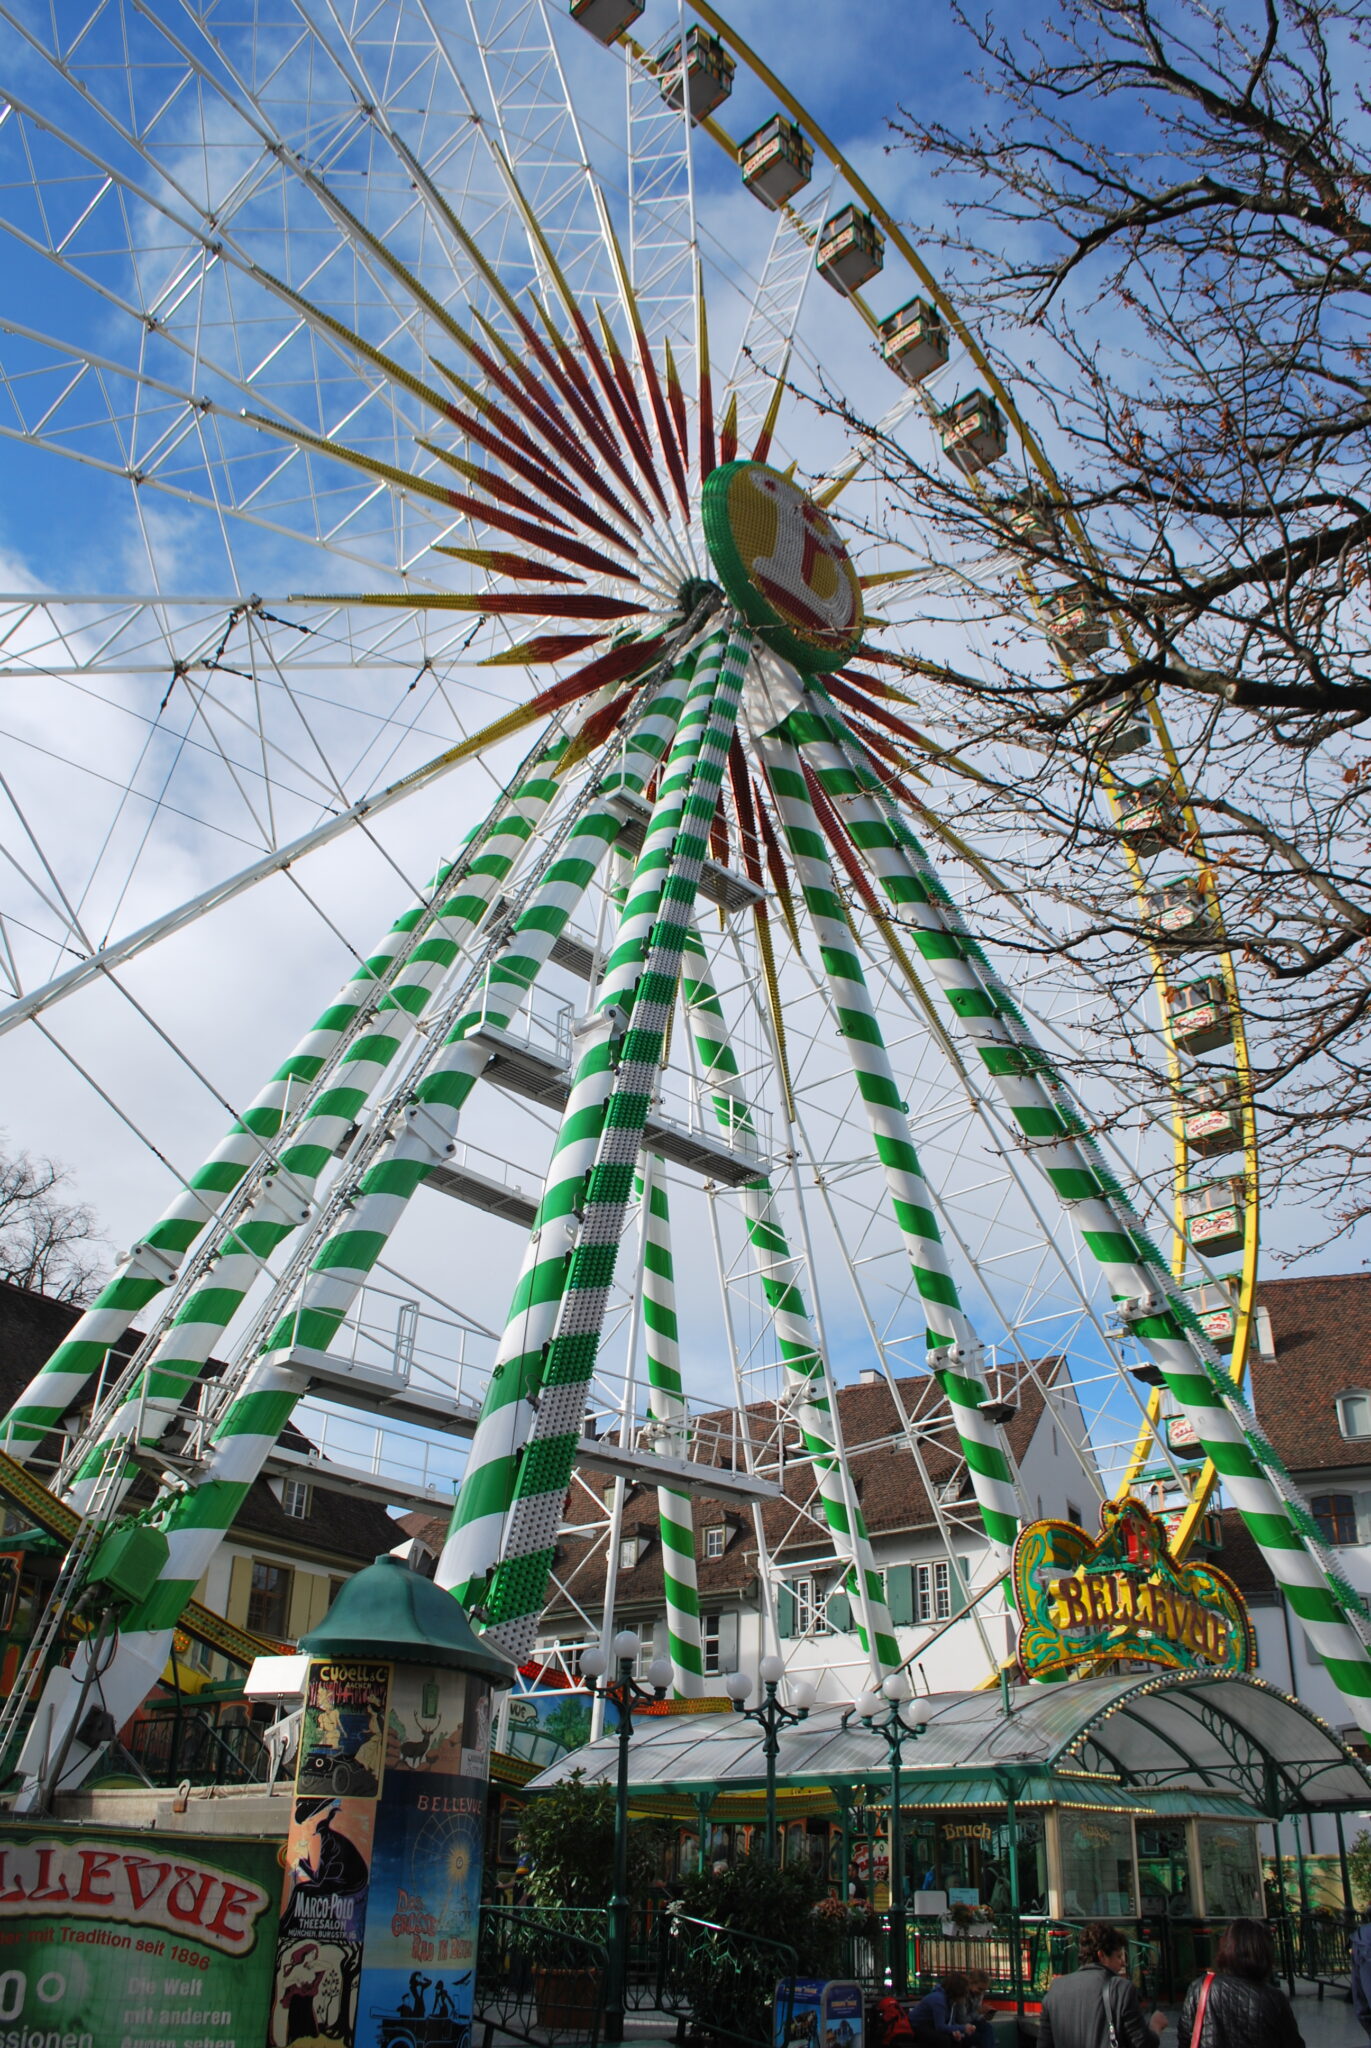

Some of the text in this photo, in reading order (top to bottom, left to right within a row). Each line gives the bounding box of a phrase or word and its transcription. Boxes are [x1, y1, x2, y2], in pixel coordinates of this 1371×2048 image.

[1053, 1573, 1230, 1664] BELLEVUE
[416, 1795, 482, 1814] BELLEVUE
[294, 1891, 355, 1920] MARCO-POLO
[300, 1918, 346, 1930] THEESALON
[28, 1928, 54, 1943] mit
[60, 1926, 131, 1949] Tradition
[135, 1939, 165, 1957] seit
[170, 1946, 211, 1971] 1896
[164, 1976, 204, 1997] Welt
[123, 2008, 232, 2026] mit anderen
